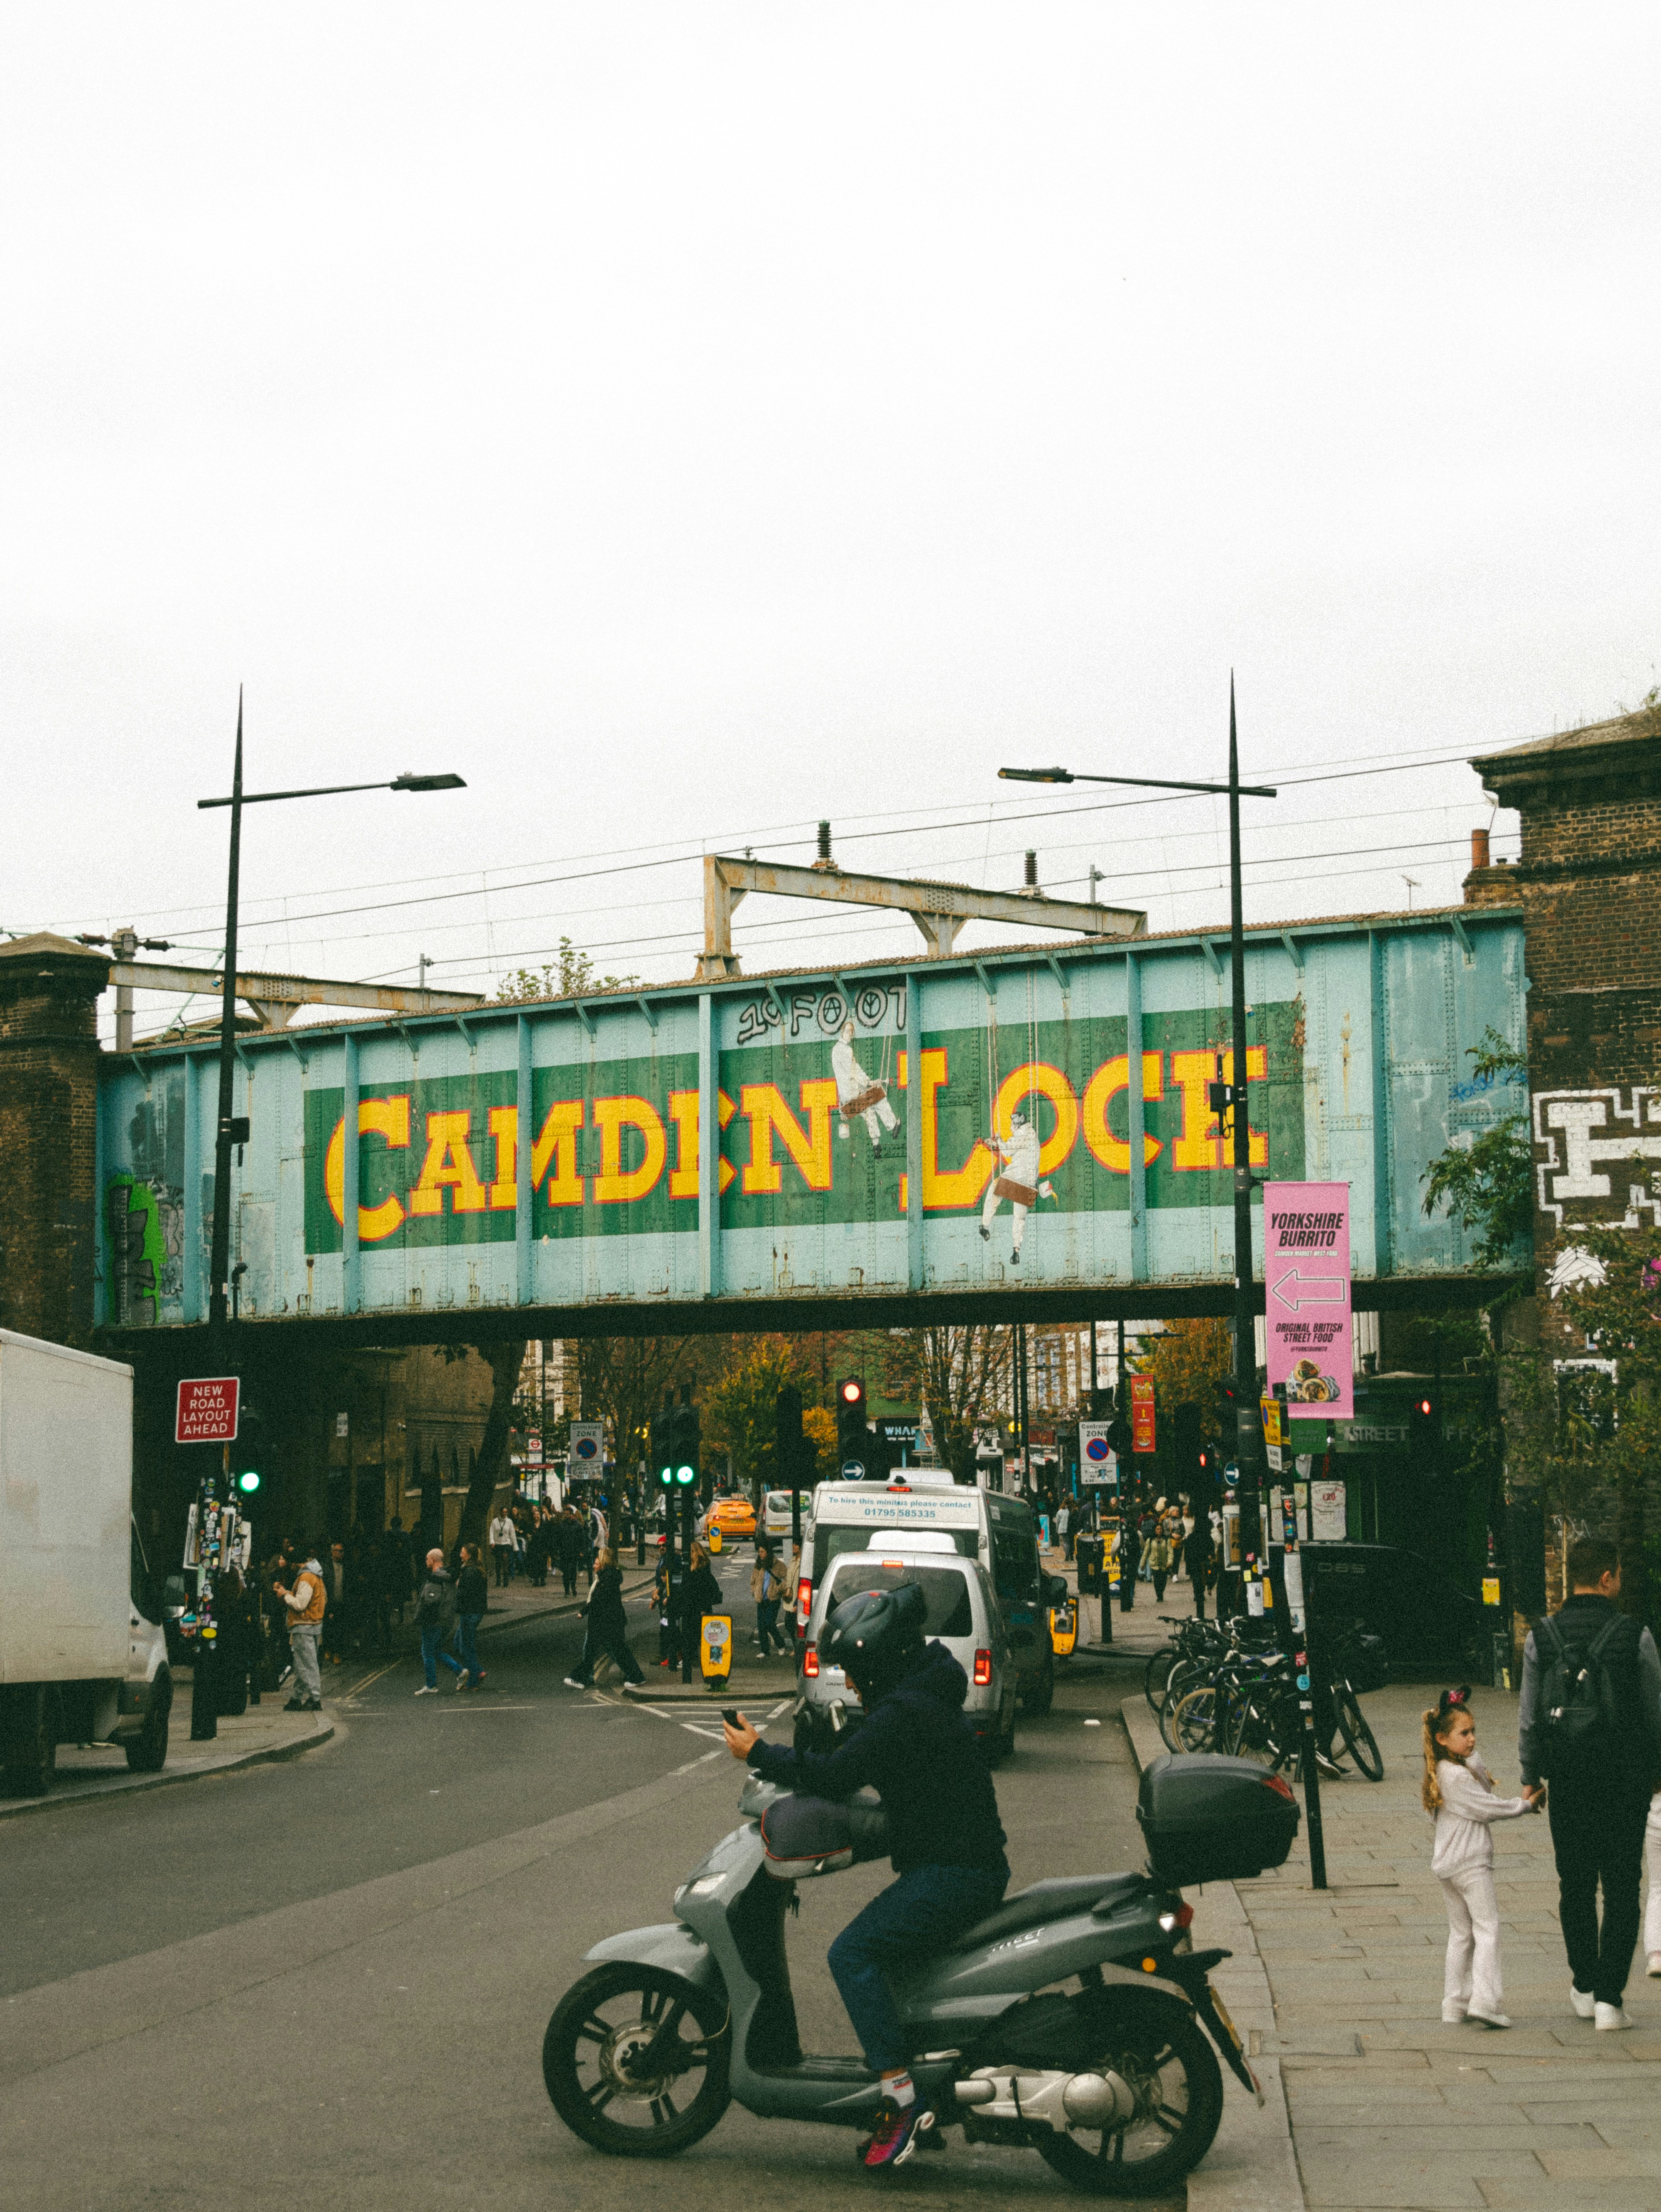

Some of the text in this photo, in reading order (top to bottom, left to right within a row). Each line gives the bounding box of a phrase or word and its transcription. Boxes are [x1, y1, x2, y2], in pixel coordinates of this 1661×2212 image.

[324, 1044, 1268, 1242] CAMDEN LOCK
[1271, 1212, 1345, 1229] YORKSHIRE
[1279, 1230, 1336, 1247] BURRITO
[1276, 1323, 1343, 1333] ORIGINAL BRITISH
[1283, 1333, 1333, 1343] STREET FOOD
[194, 1385, 223, 1397] NEW
[190, 1398, 225, 1409] ROAD
[183, 1409, 231, 1422] LAYOUT
[184, 1423, 228, 1435] AHEAD
[865, 1508, 936, 1518] 01795 585335
